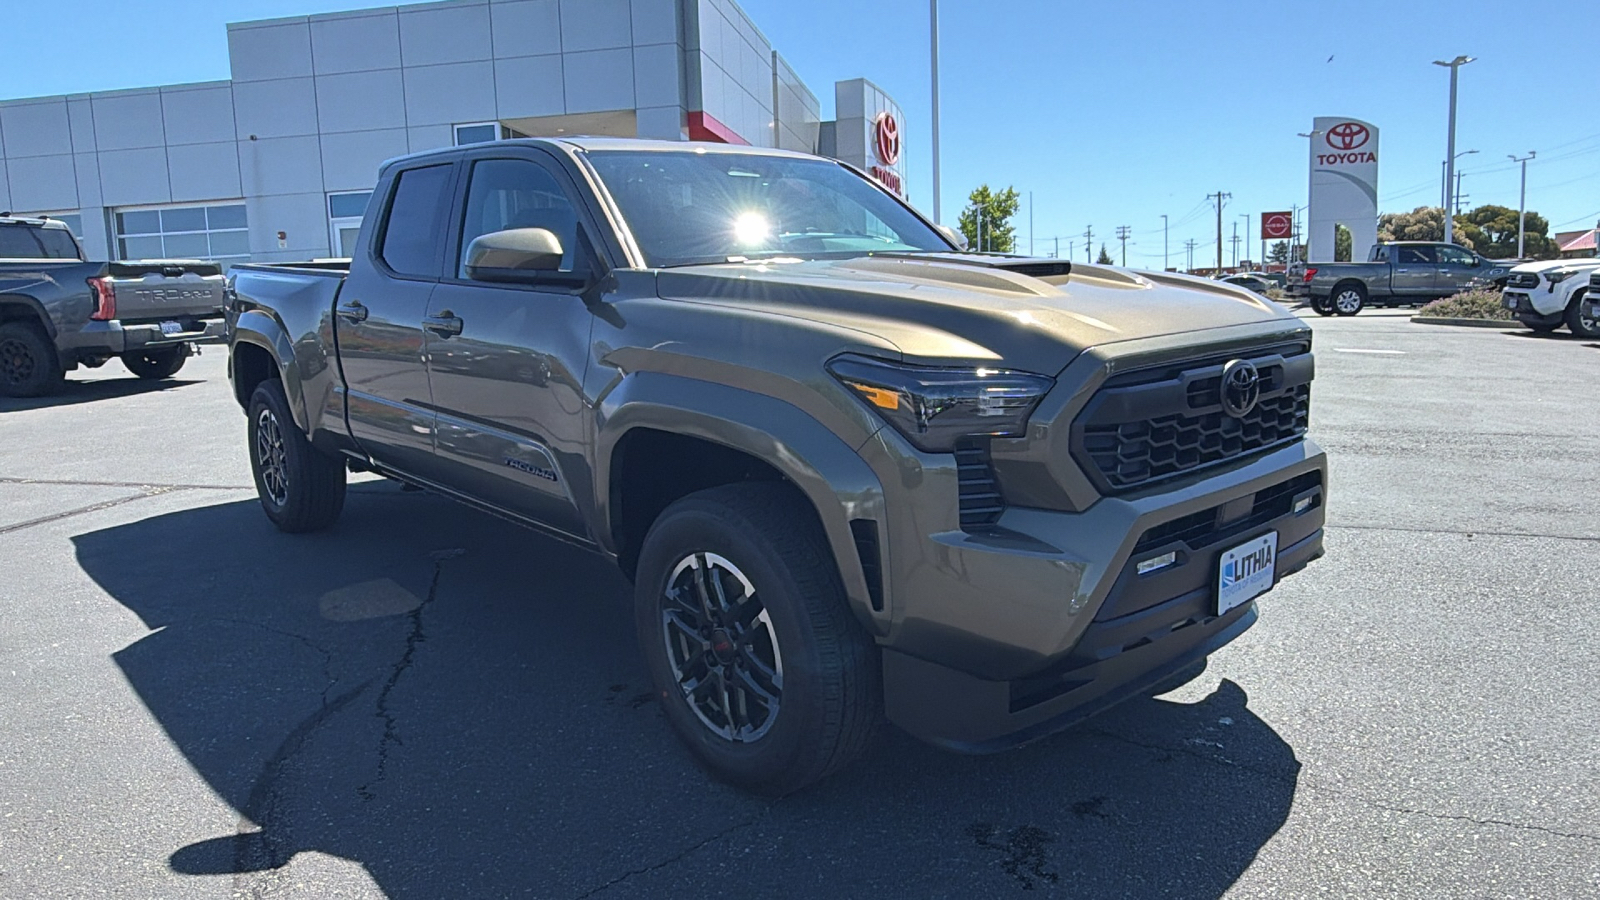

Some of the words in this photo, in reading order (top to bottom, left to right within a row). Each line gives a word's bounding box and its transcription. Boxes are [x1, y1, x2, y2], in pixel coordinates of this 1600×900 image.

[1317, 152, 1377, 165] TOYOTA
[135, 289, 179, 303] TRD
[180, 289, 212, 299] PRO
[504, 456, 557, 481] TACOMA
[1234, 544, 1272, 582] LITHIA
